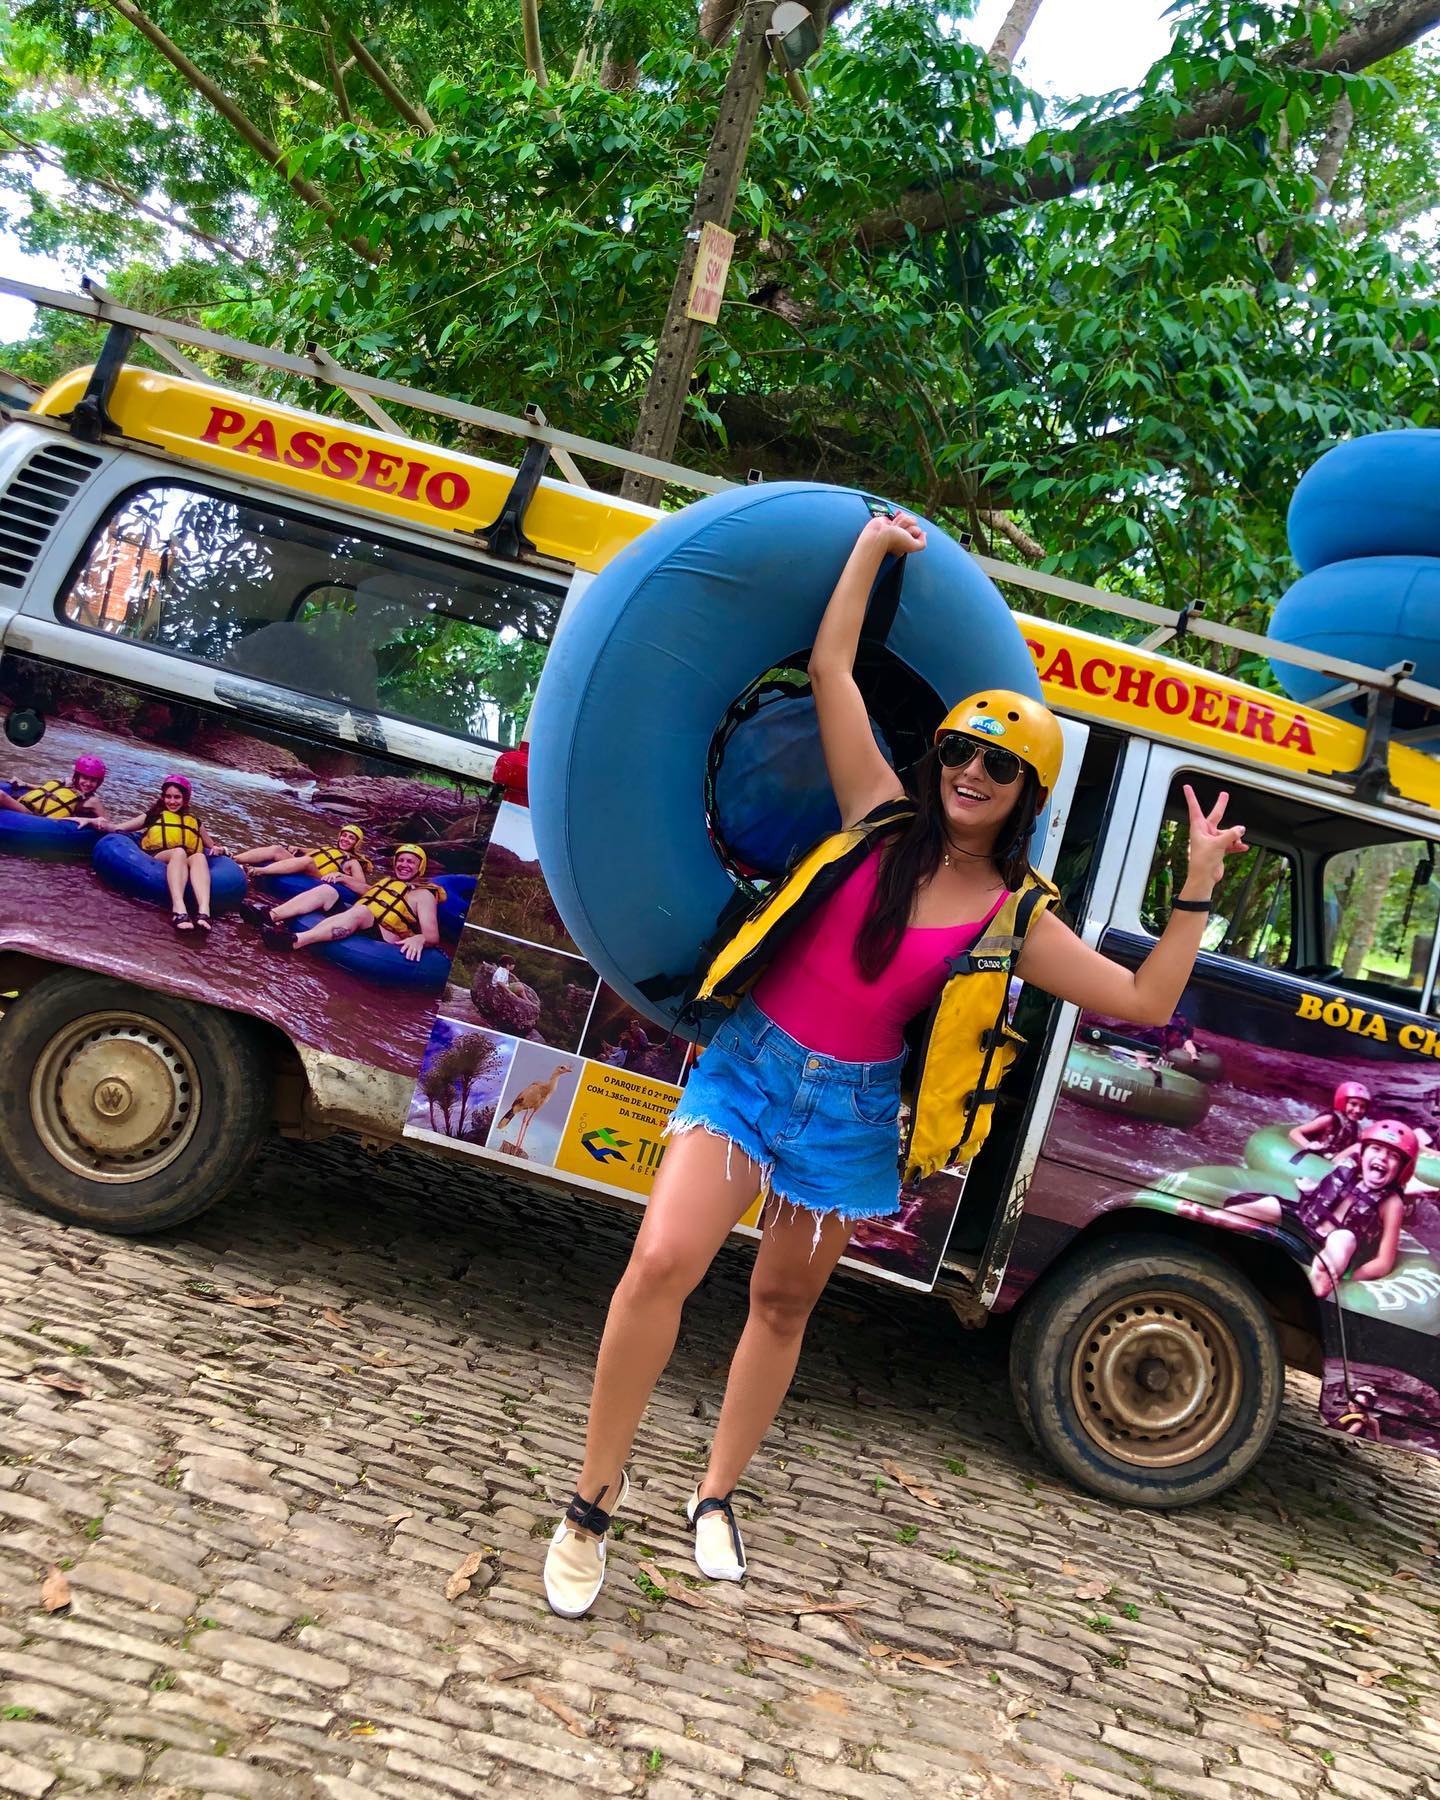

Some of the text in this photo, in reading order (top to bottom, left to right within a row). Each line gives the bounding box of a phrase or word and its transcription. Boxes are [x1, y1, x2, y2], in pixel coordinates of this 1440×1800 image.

[200, 407, 470, 511] PASSEIO
[1296, 993, 1388, 1042] BÓIA
[586, 1084, 604, 1095] COM
[604, 1090, 630, 1103] 1.385m
[631, 1098, 641, 1107] DE
[610, 1077, 641, 1093] PARQUE
[1098, 1077, 1132, 1103] Tur
[619, 1107, 630, 1117] DA
